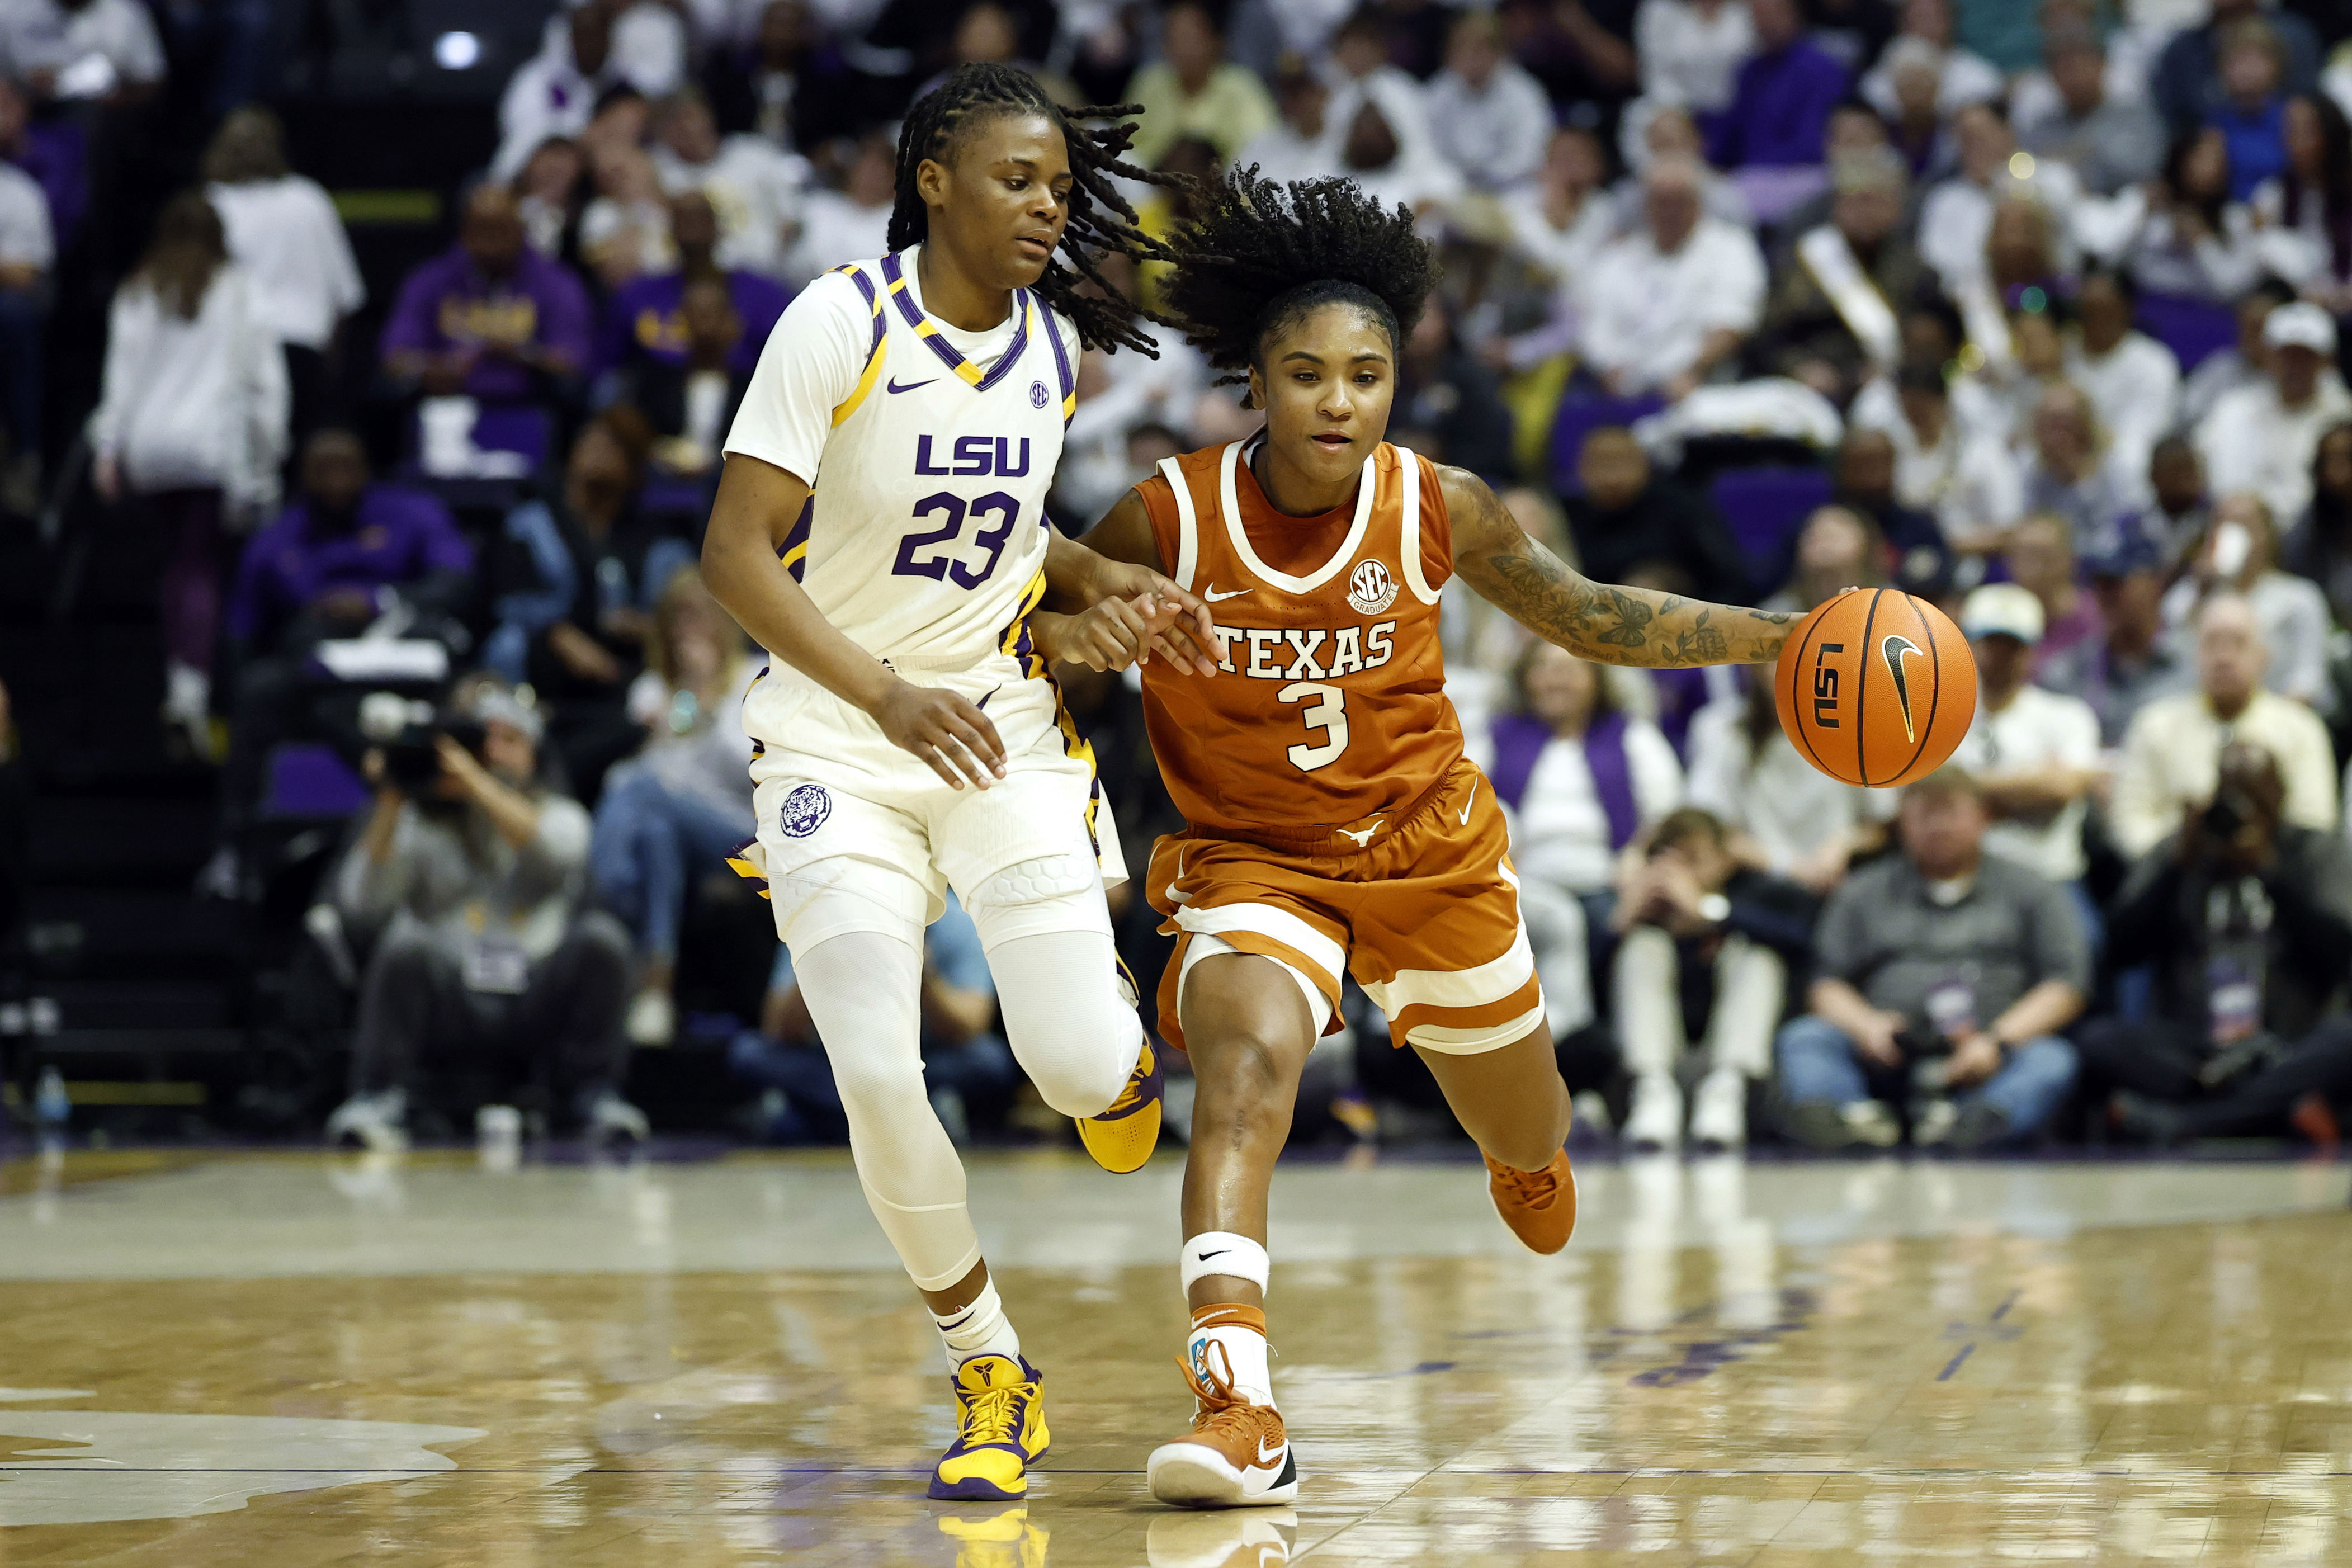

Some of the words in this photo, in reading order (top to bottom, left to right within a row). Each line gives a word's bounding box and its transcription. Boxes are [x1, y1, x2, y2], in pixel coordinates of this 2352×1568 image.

[1032, 382, 1047, 406] SEC
[915, 434, 1030, 477] LSU
[891, 491, 1021, 591] 23
[1353, 561, 1388, 602] SEC
[1353, 593, 1394, 615] GRADUATE
[1212, 619, 1397, 681] TEXAS
[1813, 643, 1844, 729] LSU
[1276, 681, 1349, 772] 3
